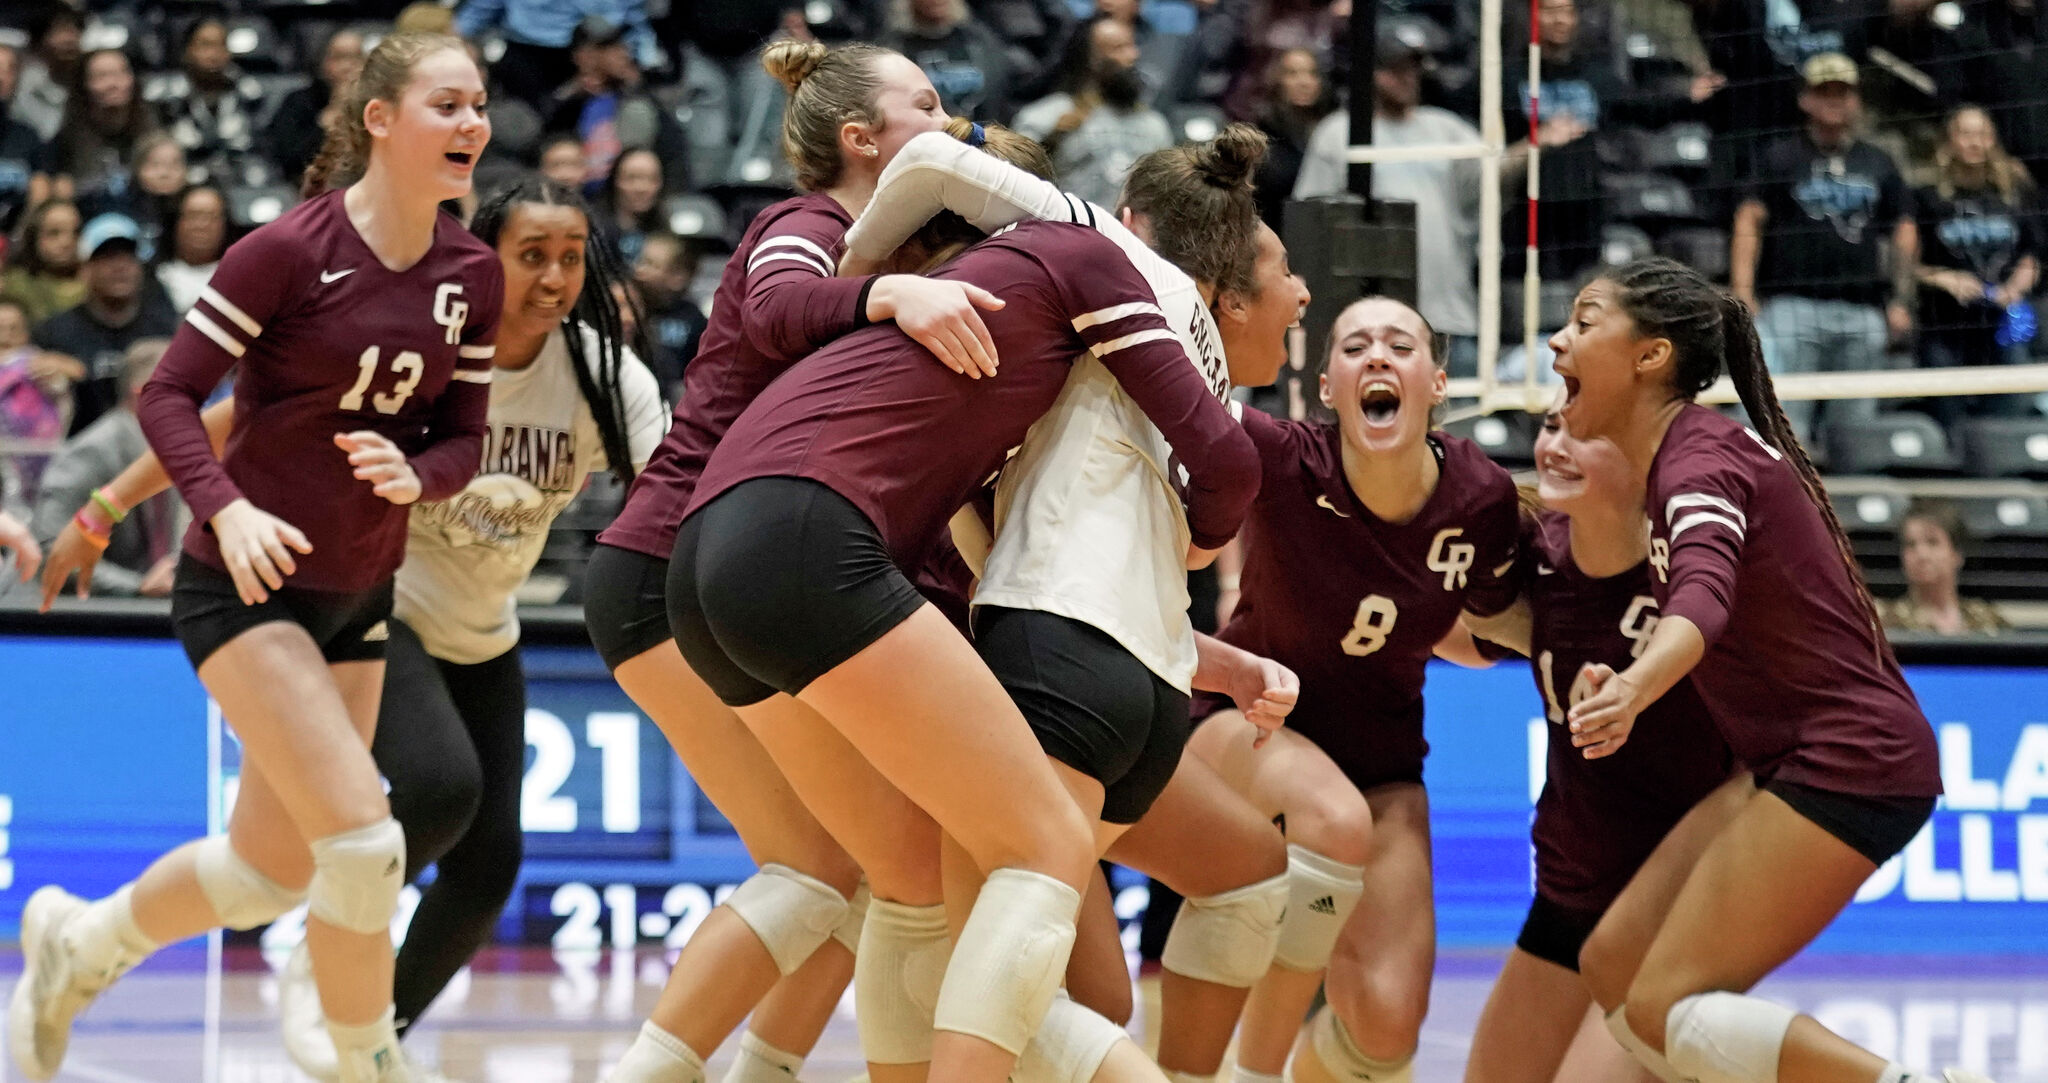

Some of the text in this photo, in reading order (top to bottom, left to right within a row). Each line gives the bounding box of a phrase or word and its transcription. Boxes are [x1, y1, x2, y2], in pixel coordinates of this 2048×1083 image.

[339, 345, 425, 415] 13
[1340, 594, 1398, 656] 8
[520, 708, 641, 833] 21
[551, 882, 742, 950] 21-2
